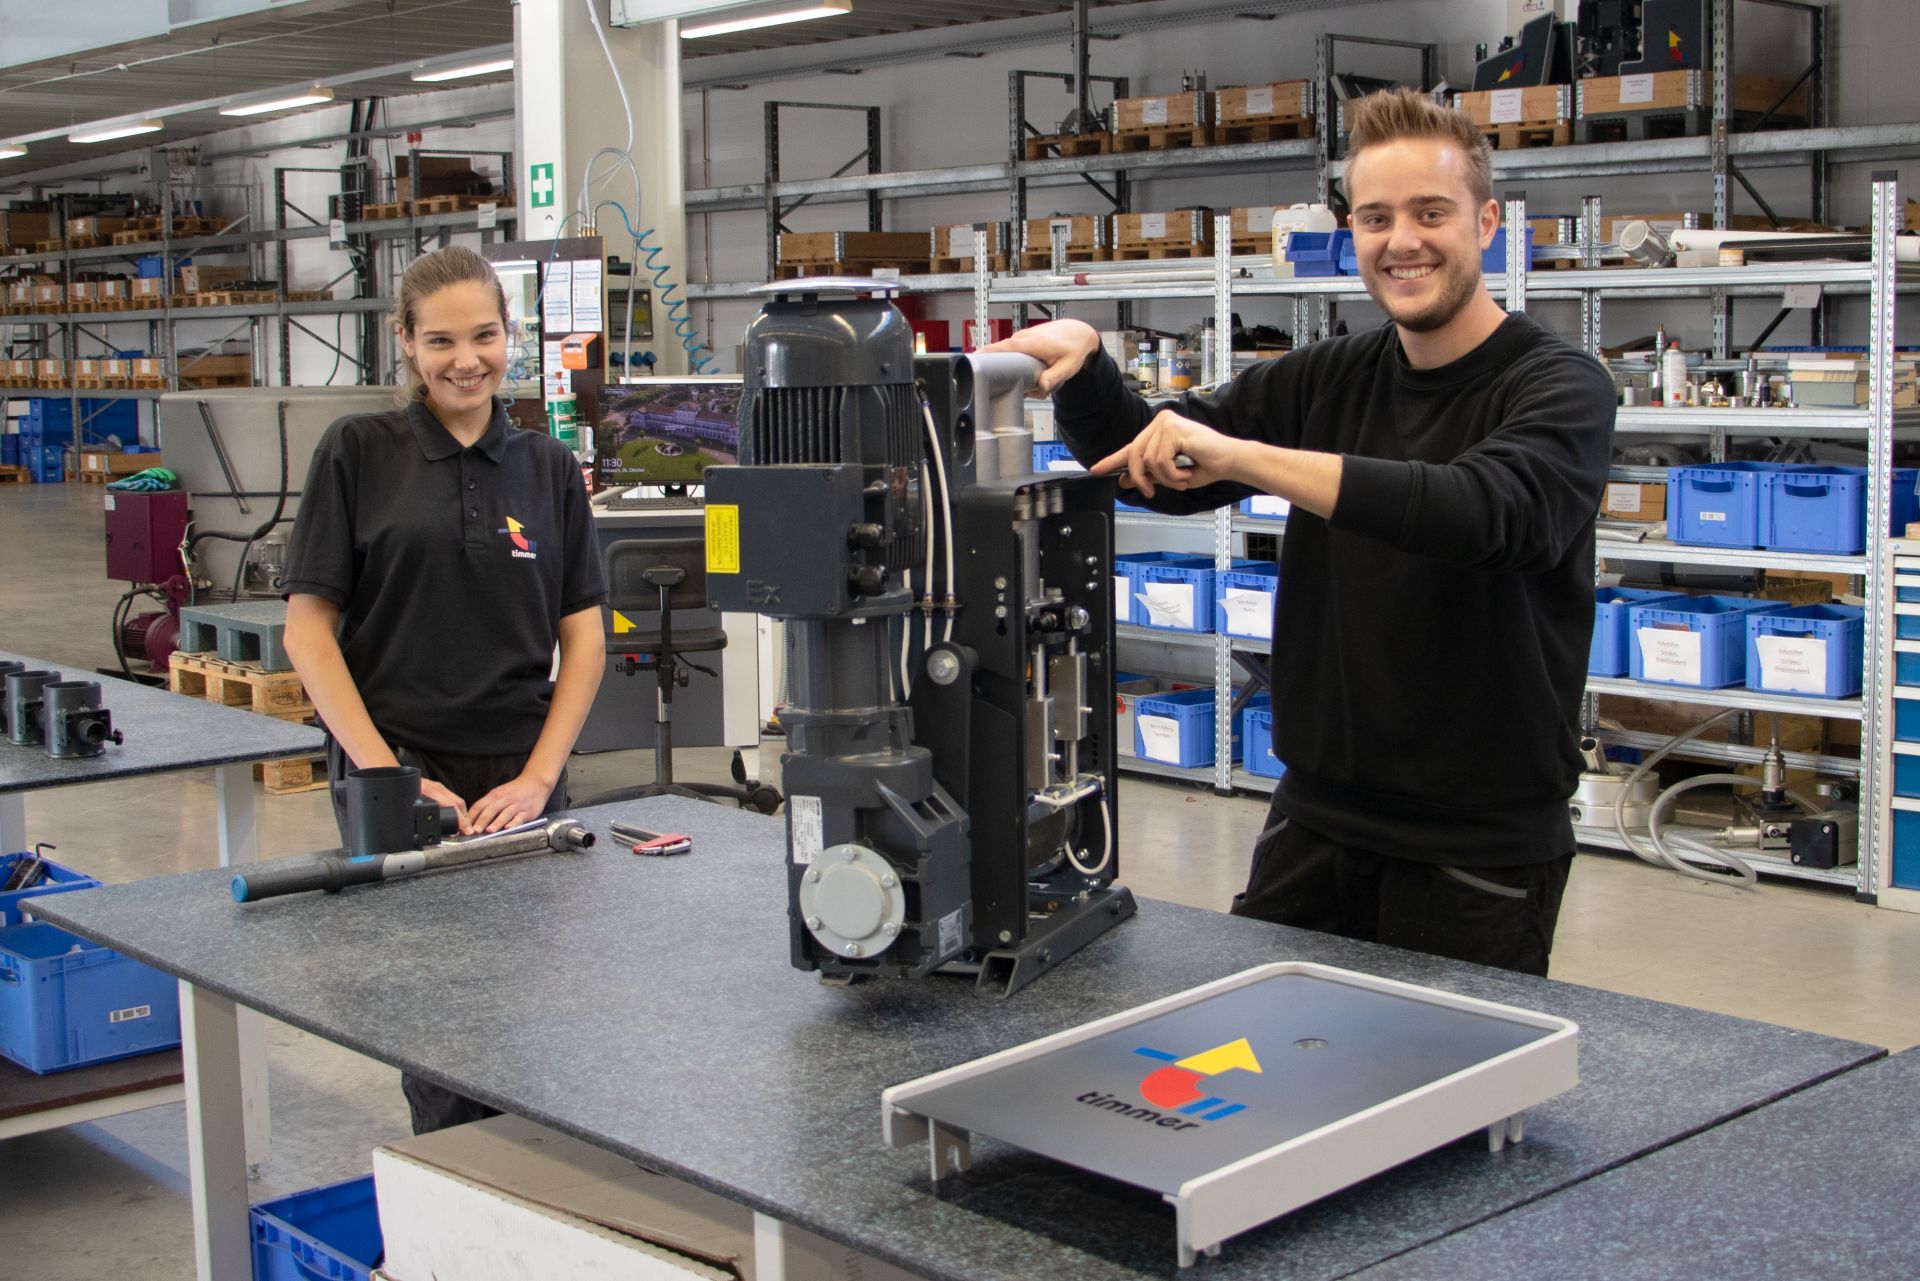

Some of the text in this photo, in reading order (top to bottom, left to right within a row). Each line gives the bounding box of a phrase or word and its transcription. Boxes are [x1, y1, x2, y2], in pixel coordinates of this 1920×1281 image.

[602, 458, 623, 467] 11:30
[746, 579, 780, 604] Ex
[1075, 1090, 1200, 1131] timmer
